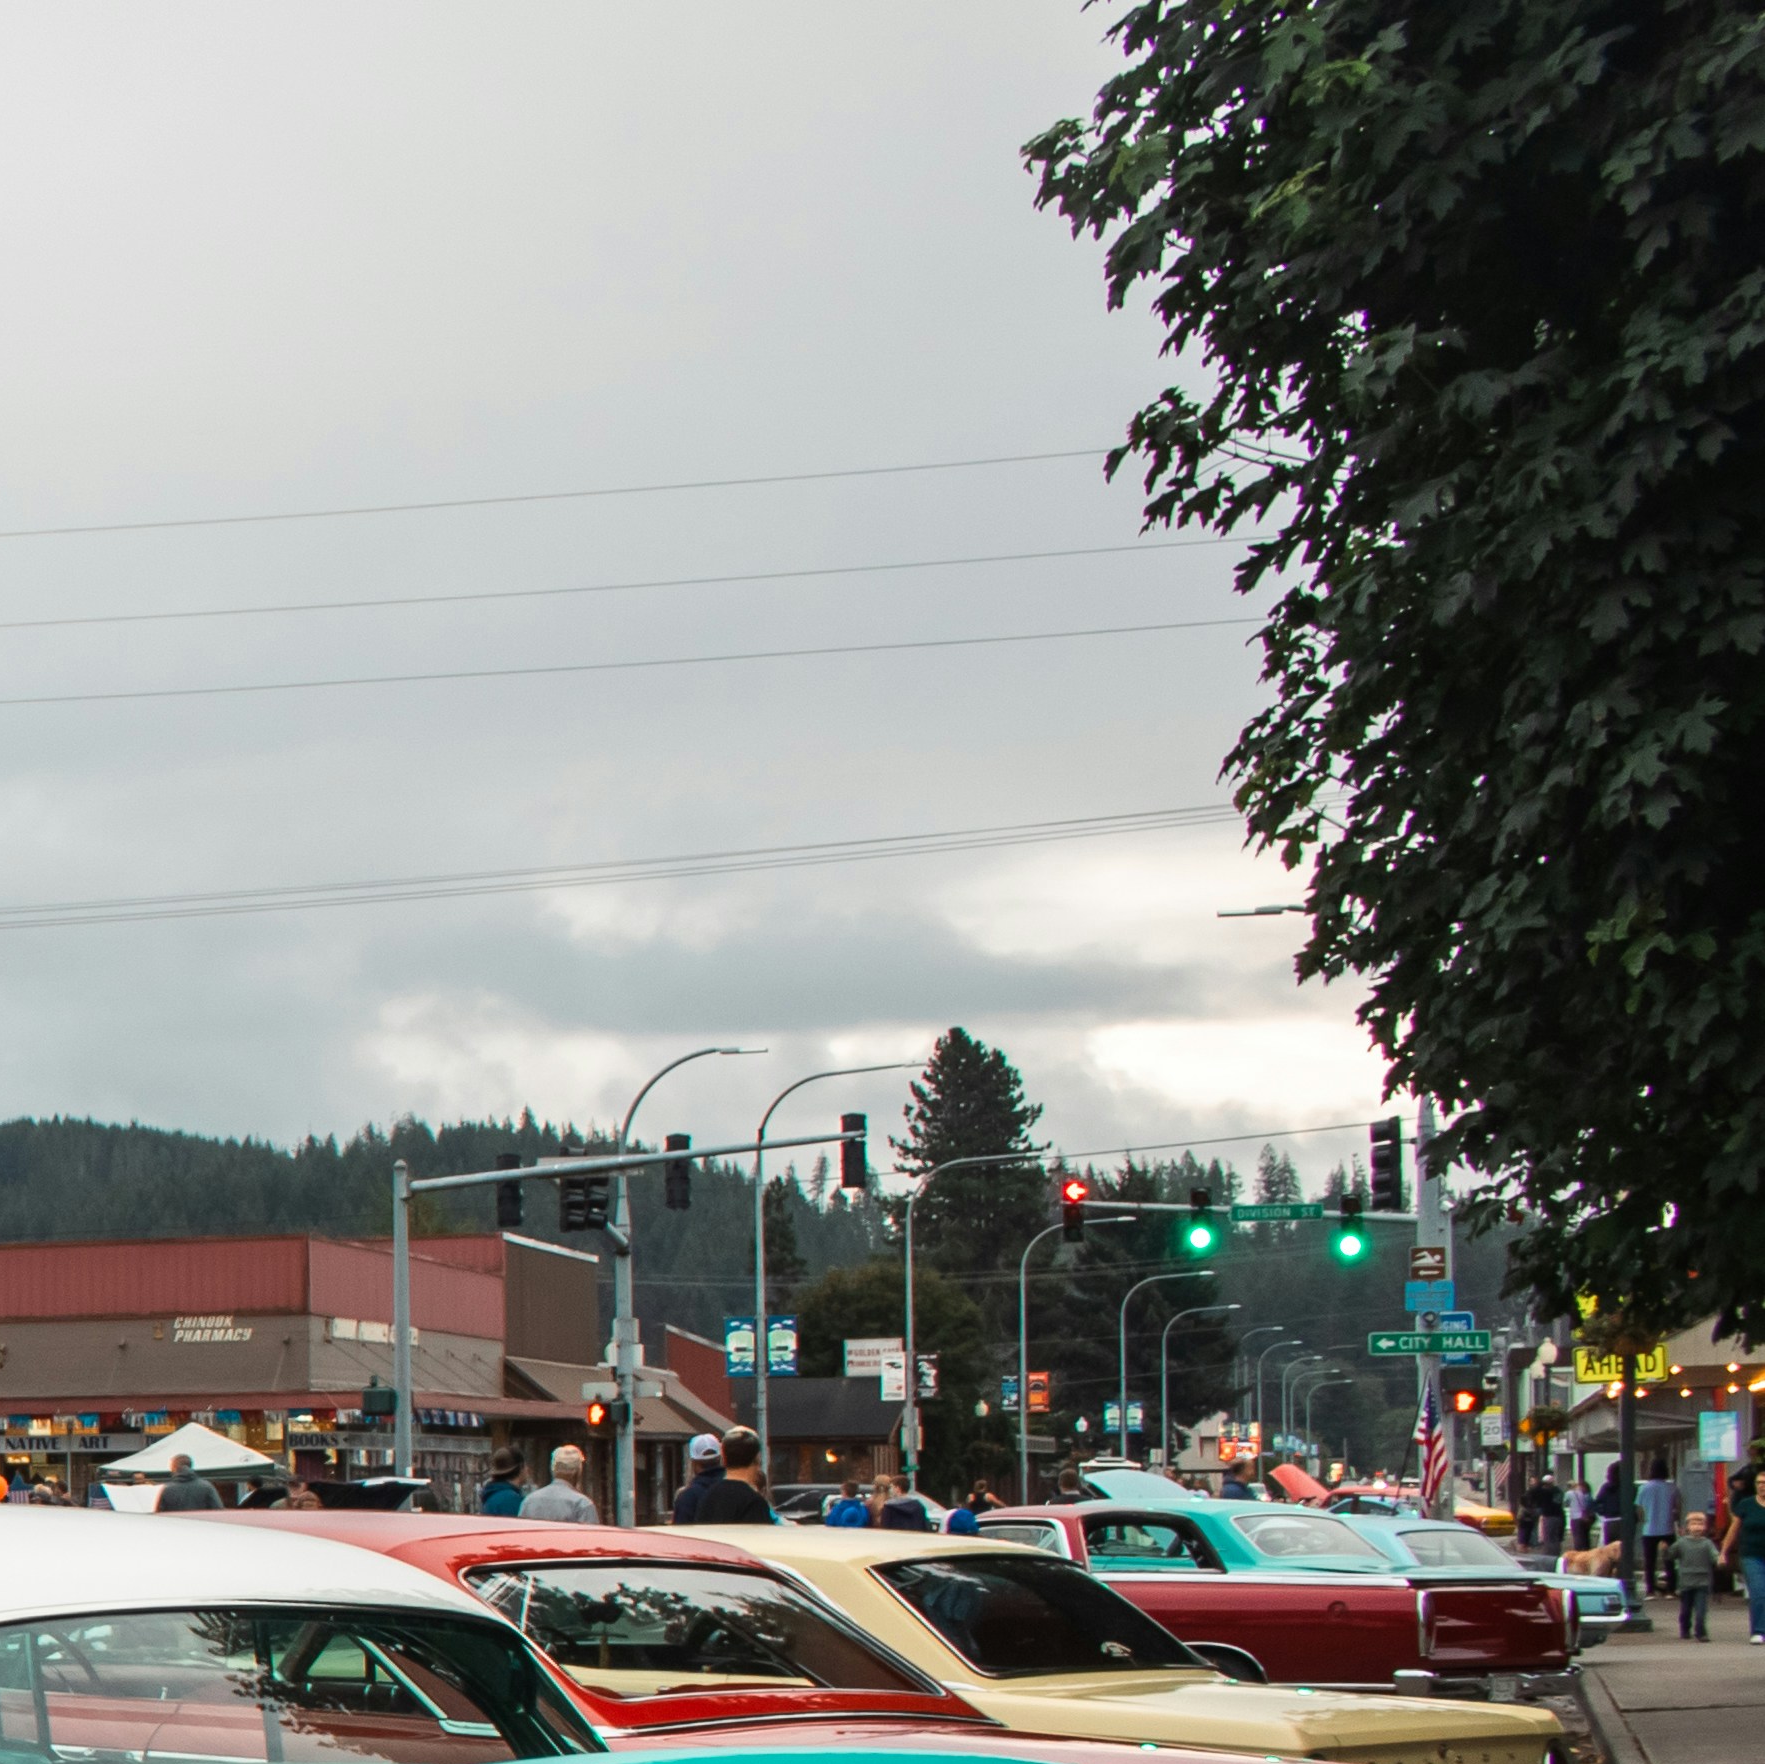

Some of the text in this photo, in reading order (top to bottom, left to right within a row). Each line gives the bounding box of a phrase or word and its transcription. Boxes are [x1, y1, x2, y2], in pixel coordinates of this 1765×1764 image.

[1237, 1208, 1291, 1219] DIVISION
[173, 1315, 233, 1329] CHINOOK
[173, 1327, 253, 1342] PHARMACY
[1399, 1336, 1485, 1349] CITY HALL
[1584, 1353, 1655, 1376] AHED
[6, 1435, 110, 1450] NATIVE ART
[289, 1433, 339, 1447] BOOKS
